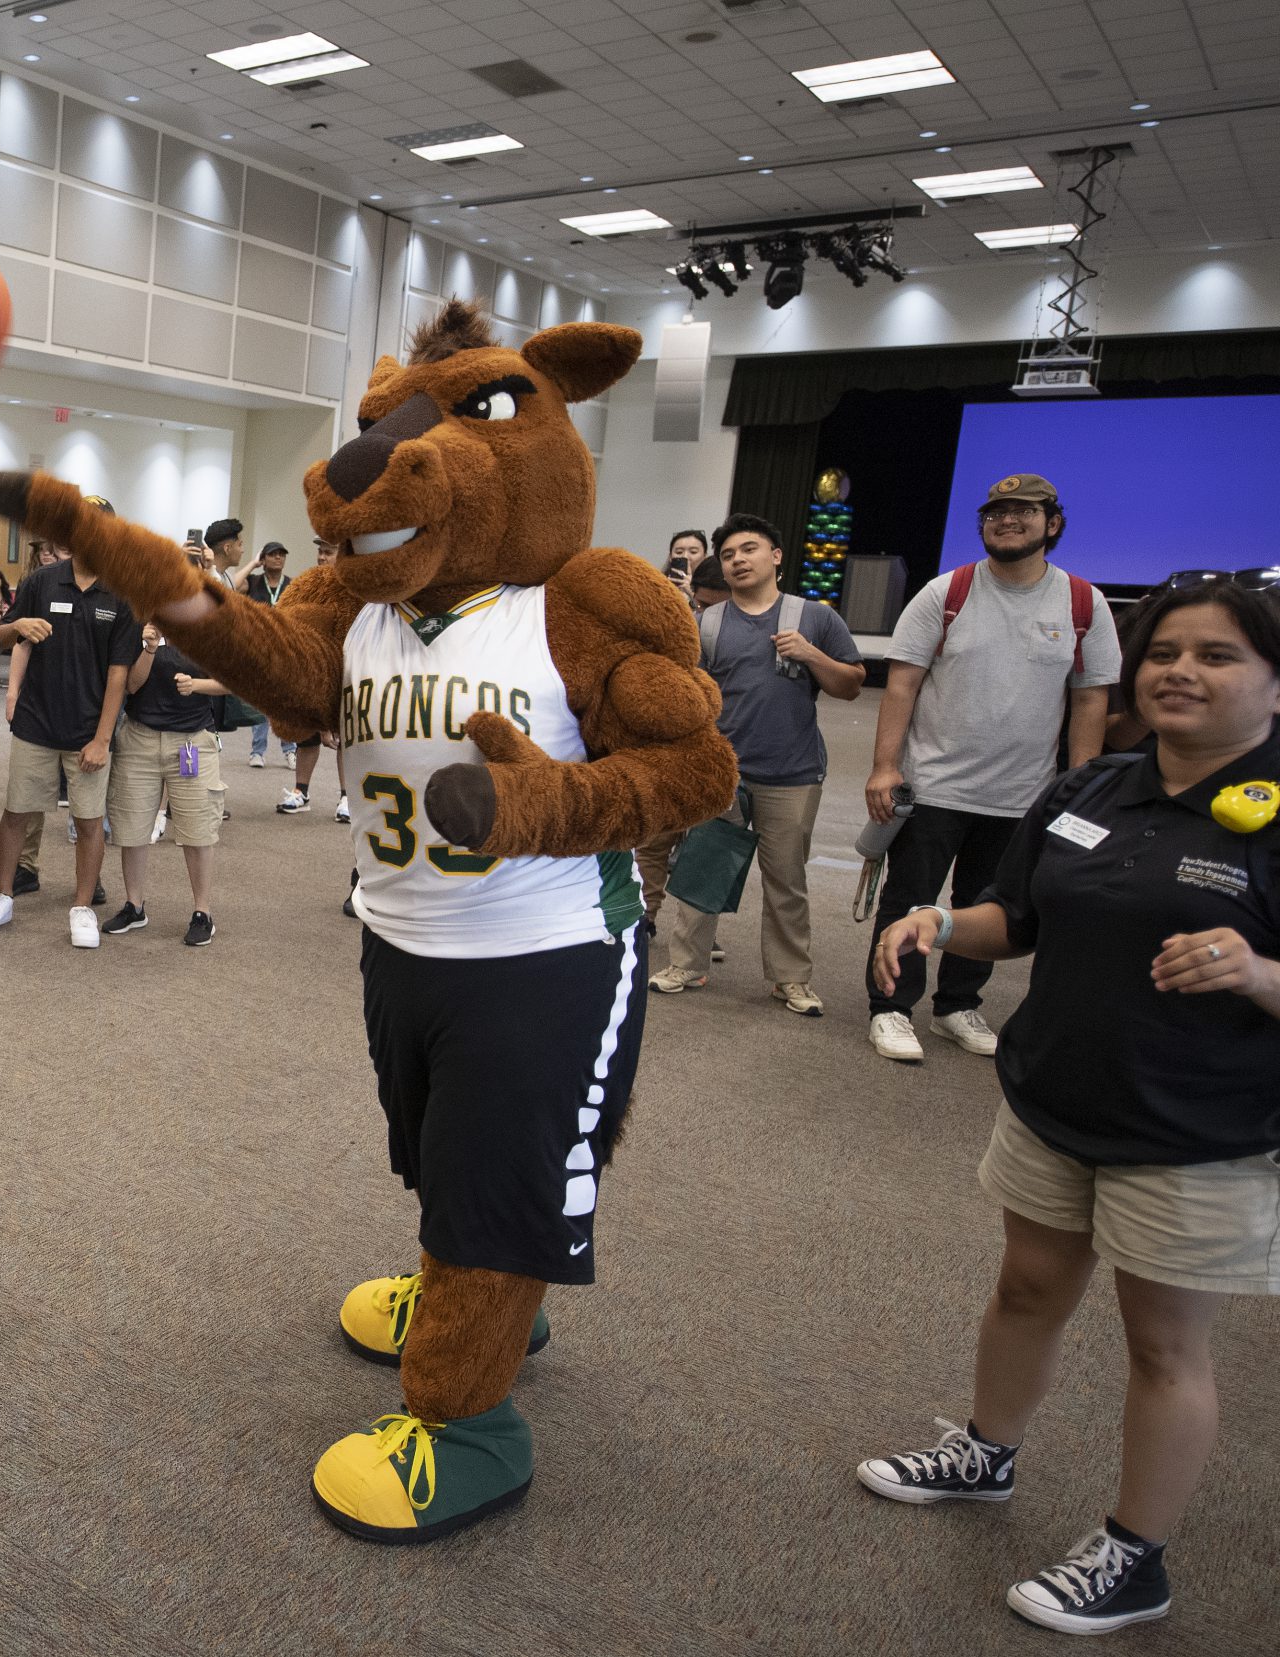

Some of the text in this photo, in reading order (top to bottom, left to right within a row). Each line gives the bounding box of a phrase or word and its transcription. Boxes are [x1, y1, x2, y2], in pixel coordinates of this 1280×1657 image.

[342, 674, 532, 749] BRONCOS
[361, 772, 505, 877] 3
[1195, 858, 1221, 870] Student
